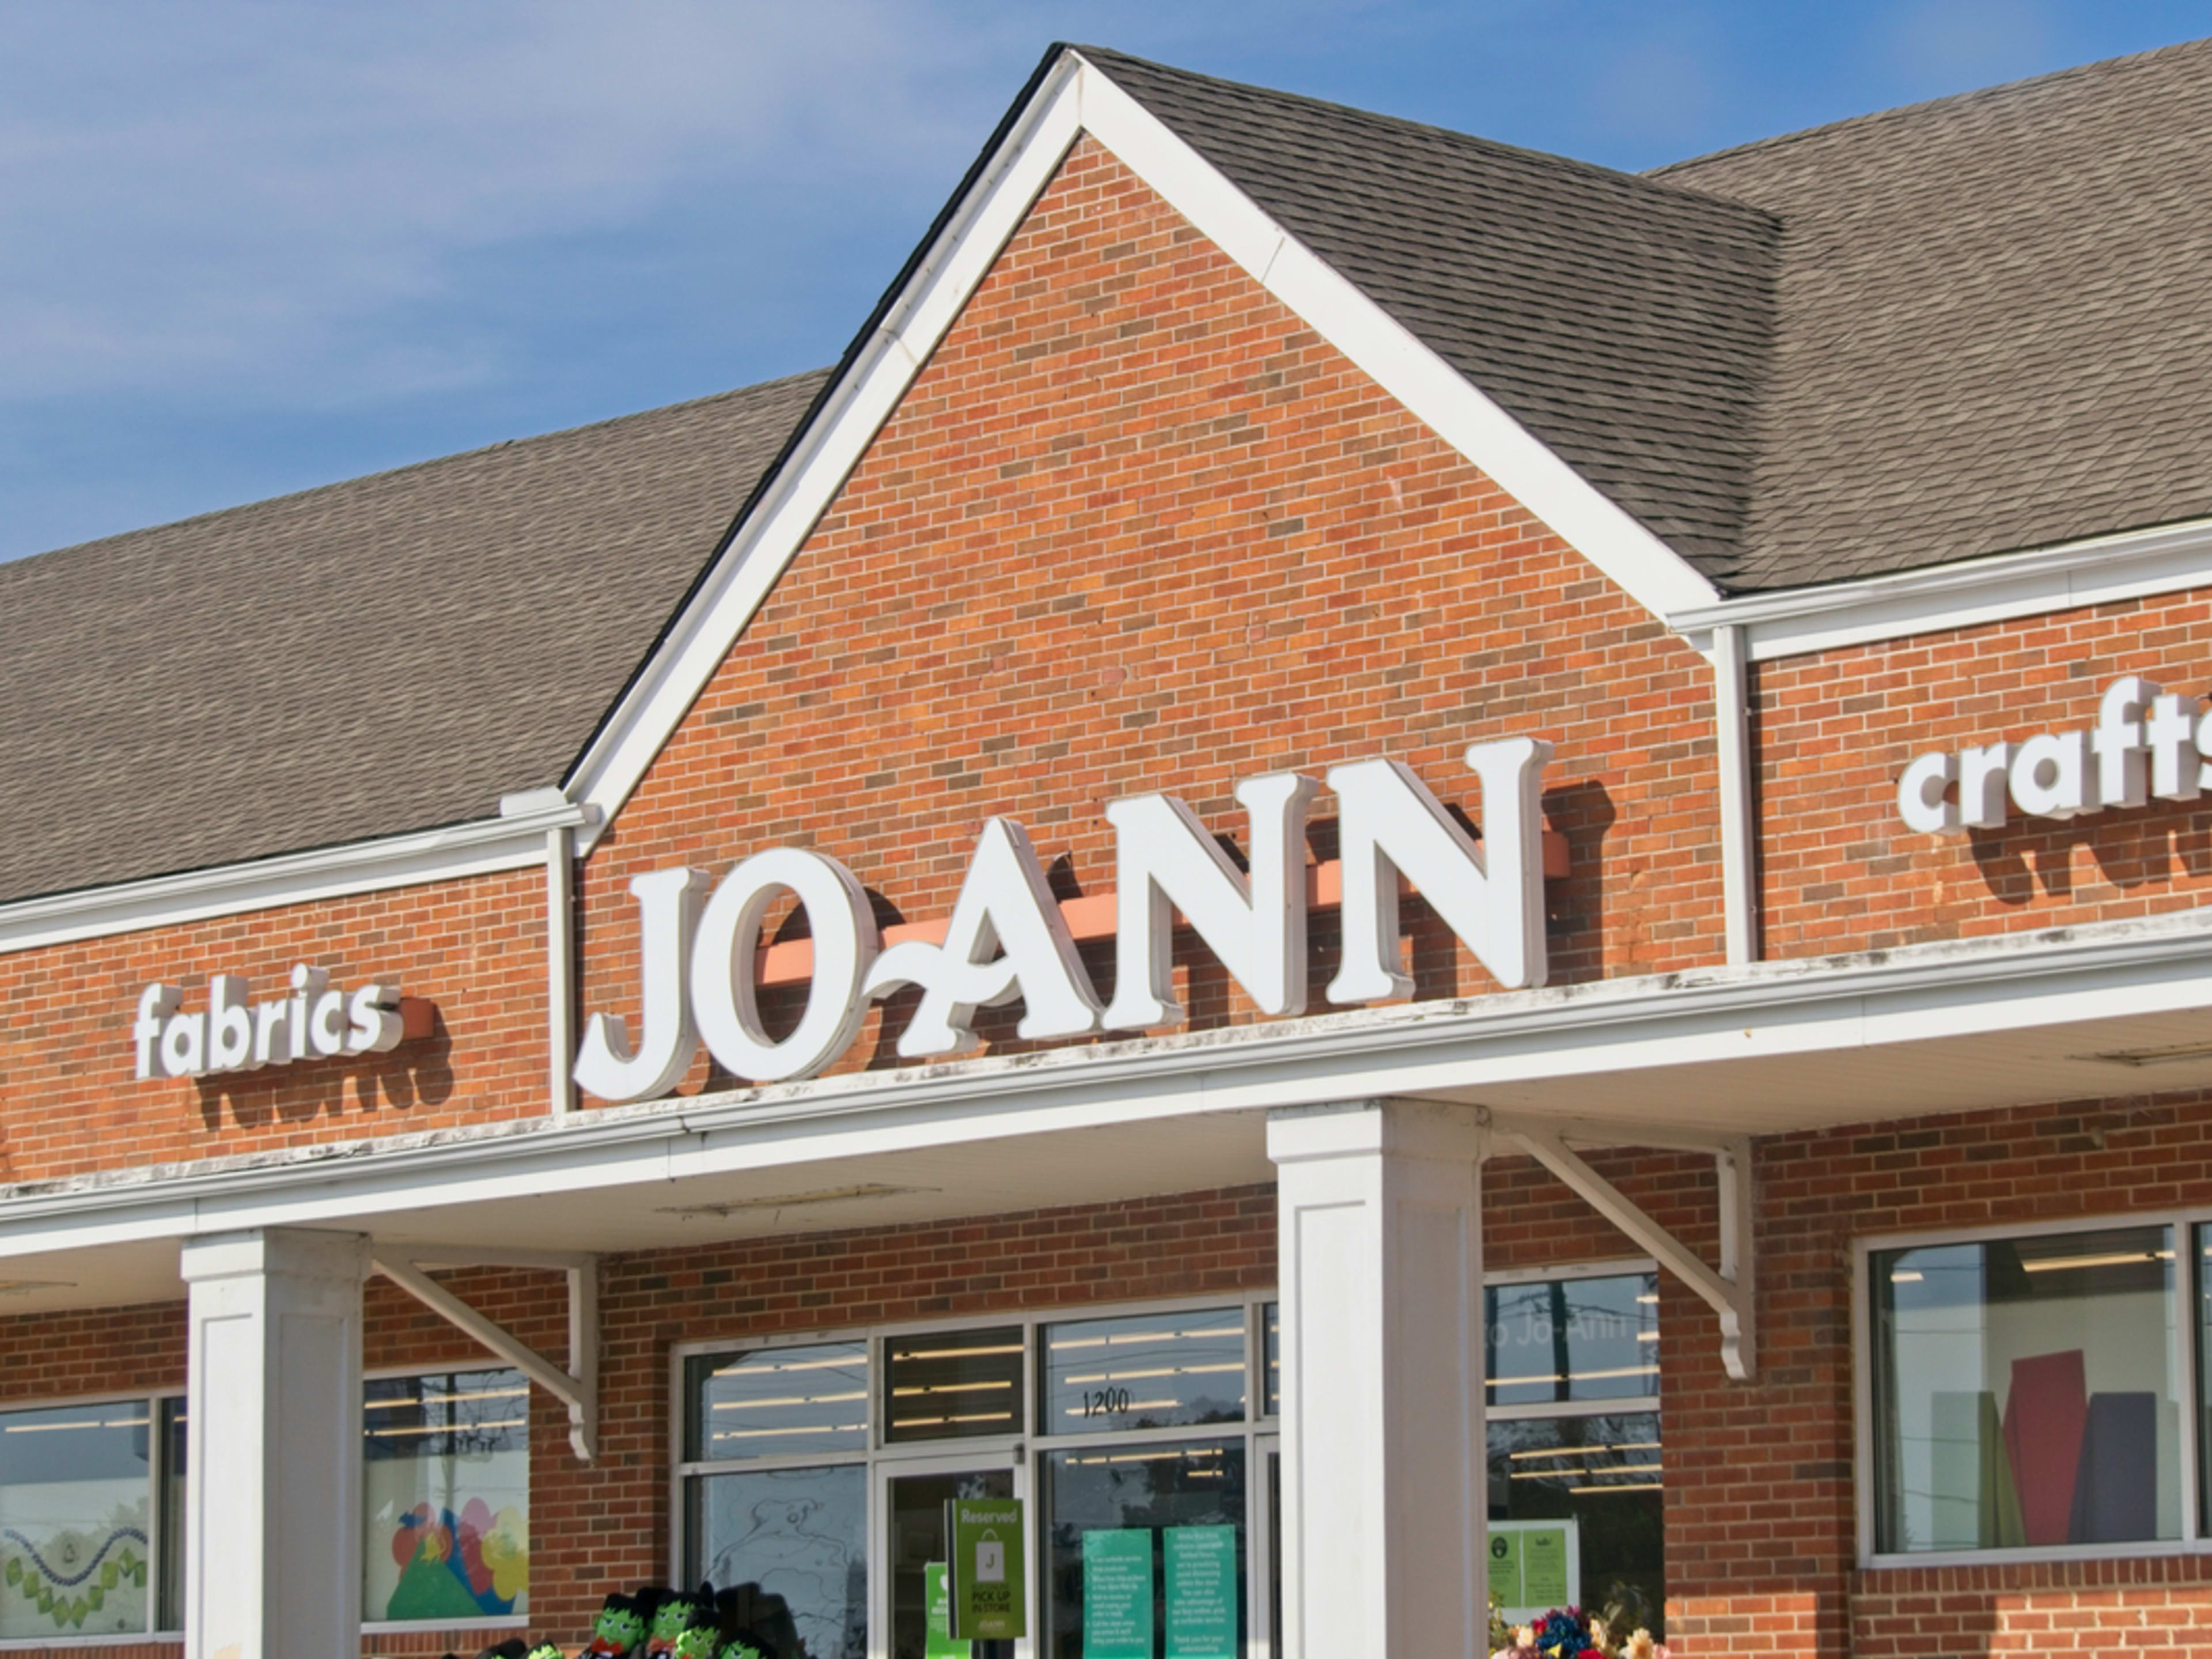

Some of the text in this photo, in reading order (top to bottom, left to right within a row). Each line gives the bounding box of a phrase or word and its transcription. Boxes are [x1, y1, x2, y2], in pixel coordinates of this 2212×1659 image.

[575, 737, 1554, 1101] JOANN
[133, 963, 403, 1080] fabrics
[1083, 1385, 1129, 1418] 1200
[960, 1507, 1017, 1524] Reserved
[986, 1552, 995, 1569] J
[972, 1590, 1010, 1602] PICK UP
[984, 1603, 1010, 1612] STORE
